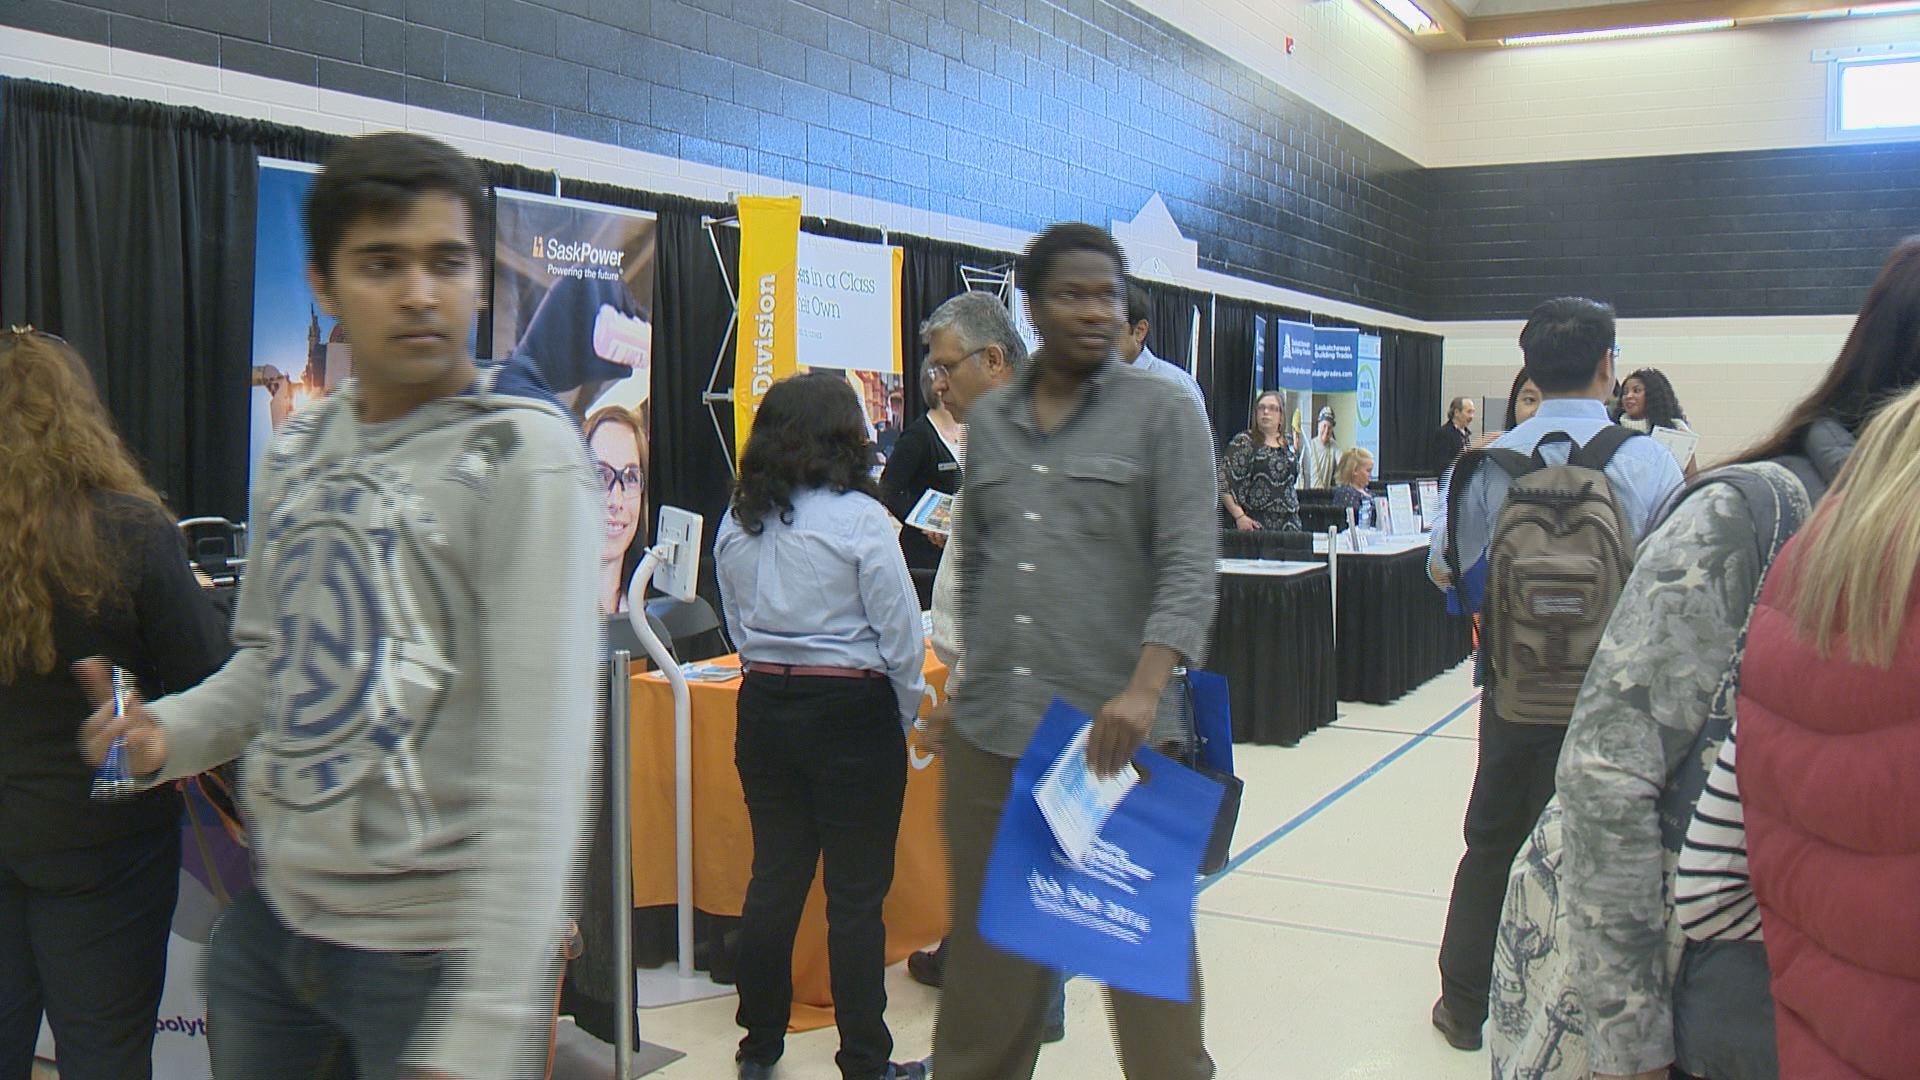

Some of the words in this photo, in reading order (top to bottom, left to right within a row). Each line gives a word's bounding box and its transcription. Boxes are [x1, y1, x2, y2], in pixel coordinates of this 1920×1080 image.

[546, 238, 624, 266] SaskPower
[547, 263, 583, 279] Powering
[584, 268, 597, 278] the
[811, 266, 823, 287] in
[826, 273, 836, 288] a
[839, 270, 875, 294] Class
[811, 295, 841, 319] Own
[753, 274, 776, 396] Division
[1314, 351, 1336, 360] Building
